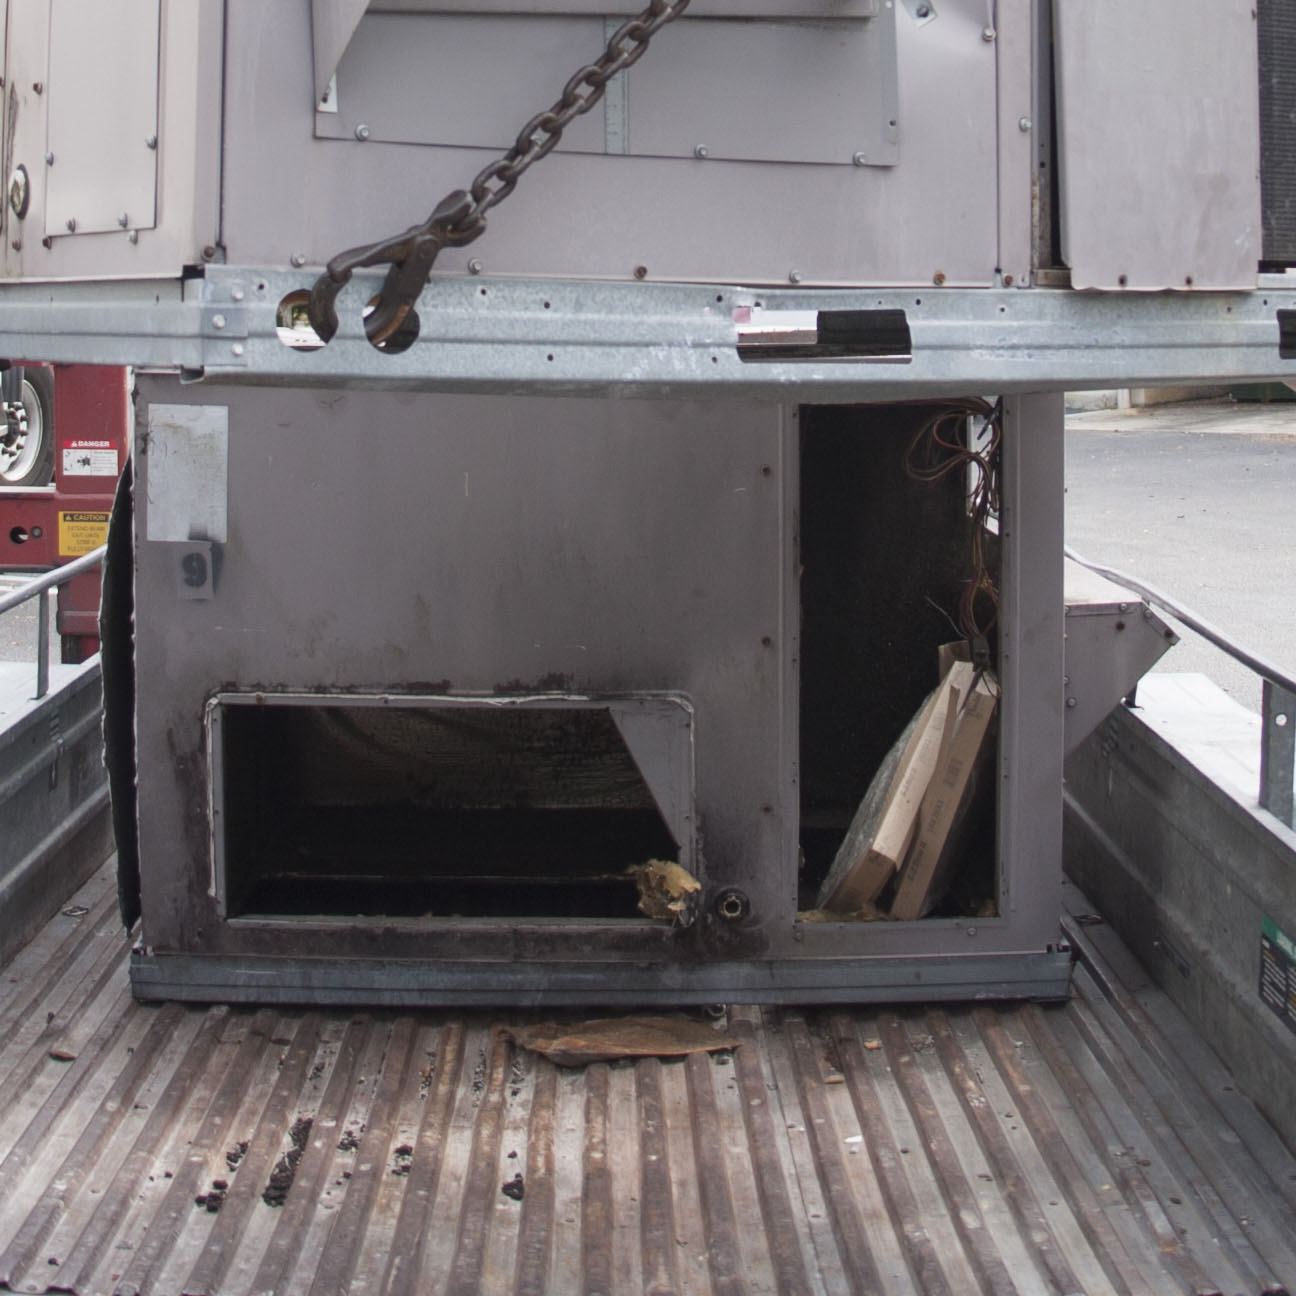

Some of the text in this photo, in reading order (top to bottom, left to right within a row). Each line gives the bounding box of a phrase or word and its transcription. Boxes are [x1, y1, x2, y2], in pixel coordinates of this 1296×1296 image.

[77, 440, 110, 448] DANGER
[73, 513, 106, 521] CAUTION
[181, 552, 208, 588] 9
